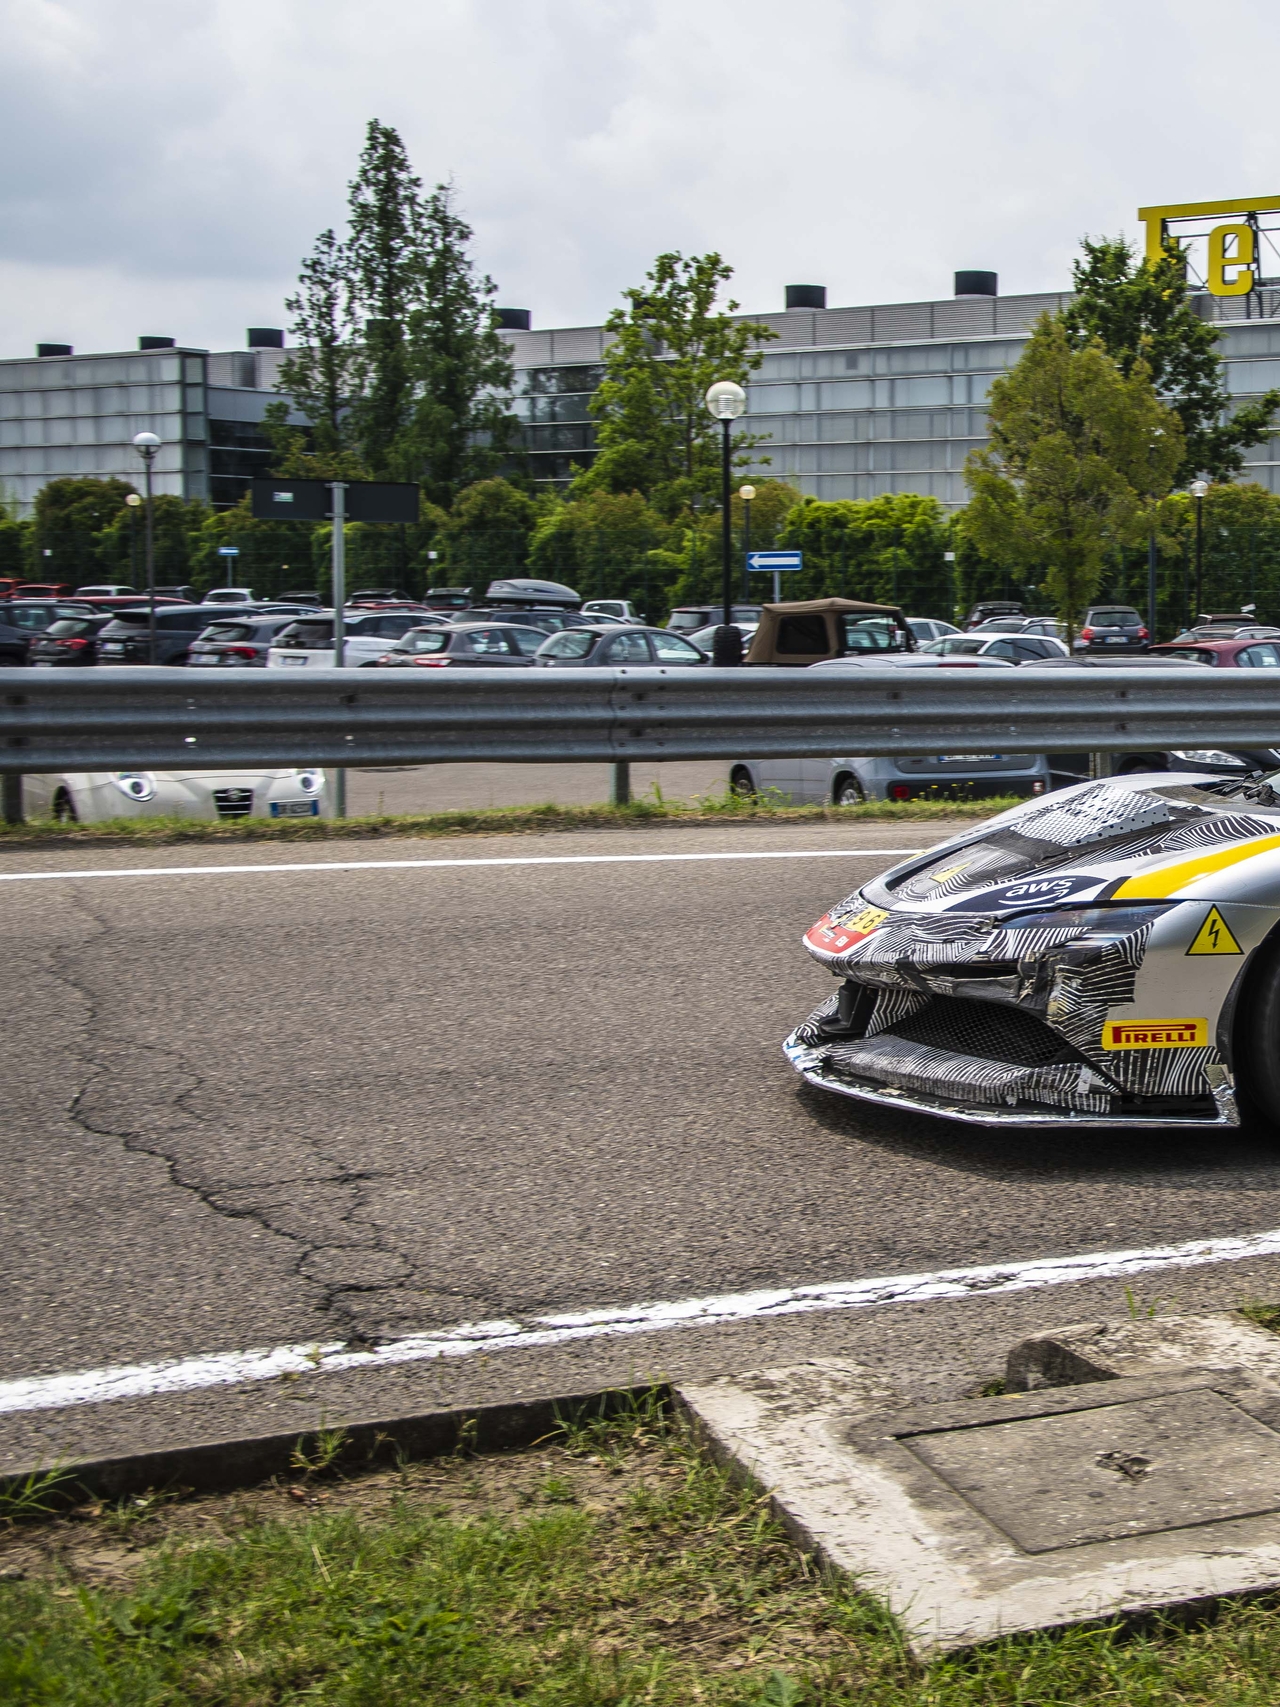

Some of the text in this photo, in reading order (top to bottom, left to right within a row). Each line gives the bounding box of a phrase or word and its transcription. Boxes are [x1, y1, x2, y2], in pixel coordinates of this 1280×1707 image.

[1005, 878, 1076, 897] aws
[852, 910, 882, 930] 96
[1112, 1023, 1198, 1044] PIRELLI
